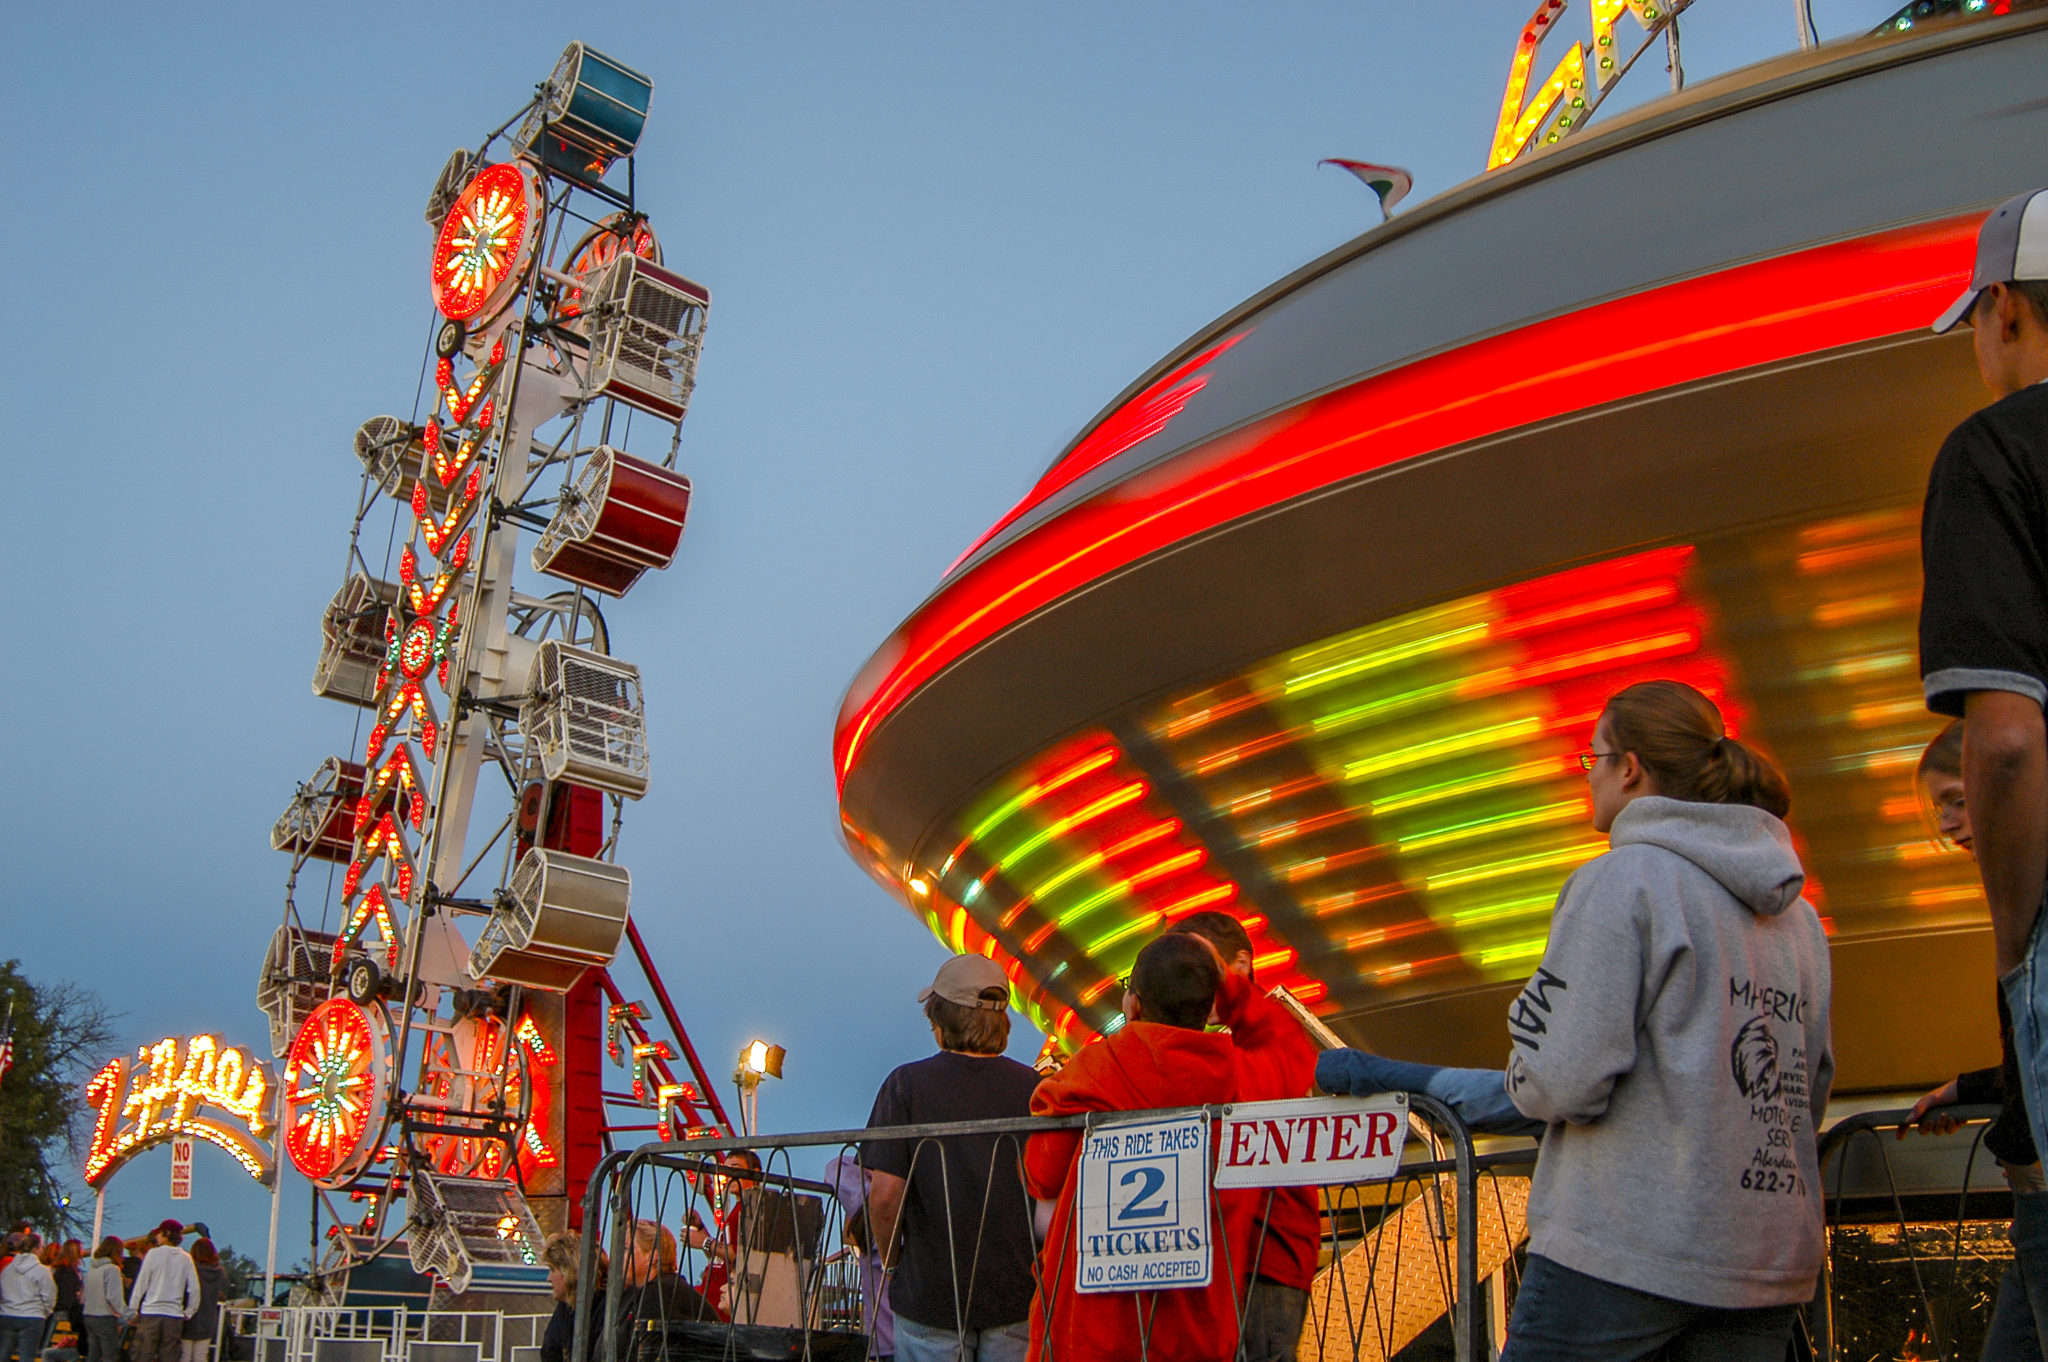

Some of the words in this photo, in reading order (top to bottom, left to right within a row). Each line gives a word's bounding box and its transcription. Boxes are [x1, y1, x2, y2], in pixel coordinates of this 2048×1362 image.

[174, 1142, 190, 1162] NO
[1092, 1136, 1120, 1160] THIS
[1124, 1132, 1153, 1156] RIDE
[1159, 1126, 1200, 1152] TAKES
[1225, 1111, 1398, 1168] ENTER
[1117, 1166, 1169, 1220] 2
[1088, 1227, 1201, 1257] TICKETS
[1087, 1266, 1104, 1283] NO
[1108, 1264, 1138, 1281] CASH
[1143, 1260, 1201, 1280] ACCEPTED
